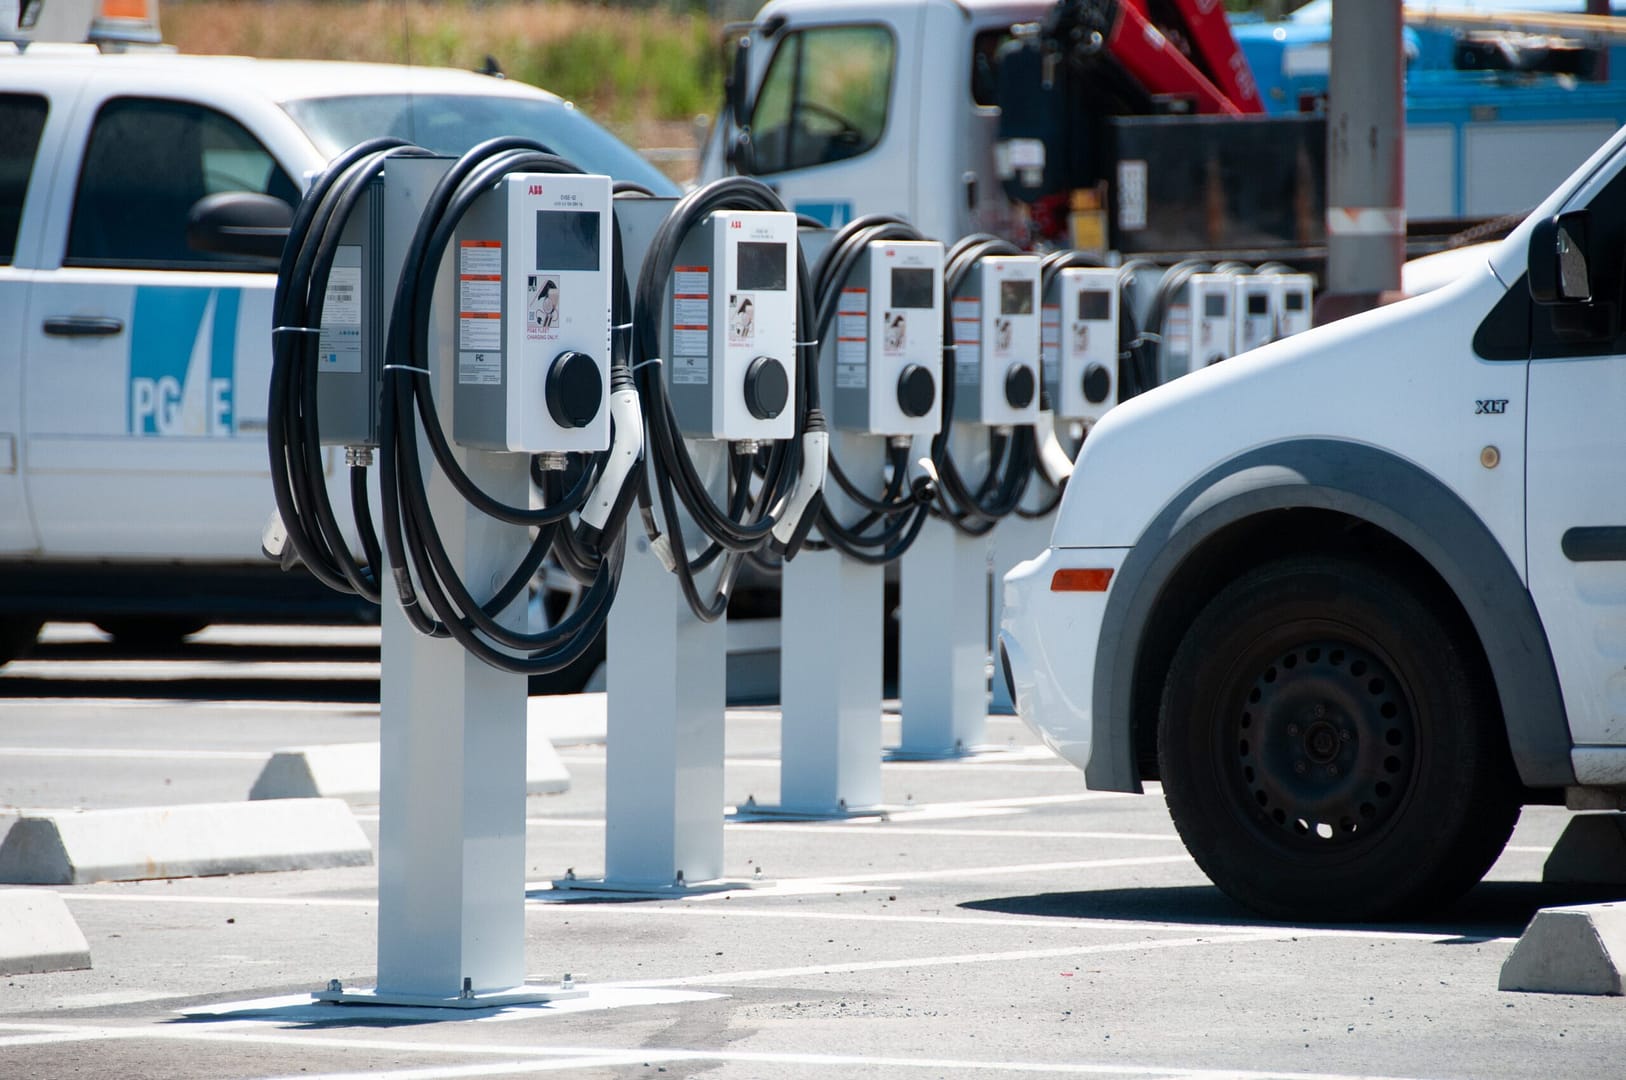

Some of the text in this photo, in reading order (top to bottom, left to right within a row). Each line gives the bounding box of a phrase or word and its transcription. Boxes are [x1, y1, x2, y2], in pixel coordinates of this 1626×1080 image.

[528, 185, 543, 195] ABB
[131, 375, 232, 436] PGE
[1475, 399, 1509, 414] XLT
